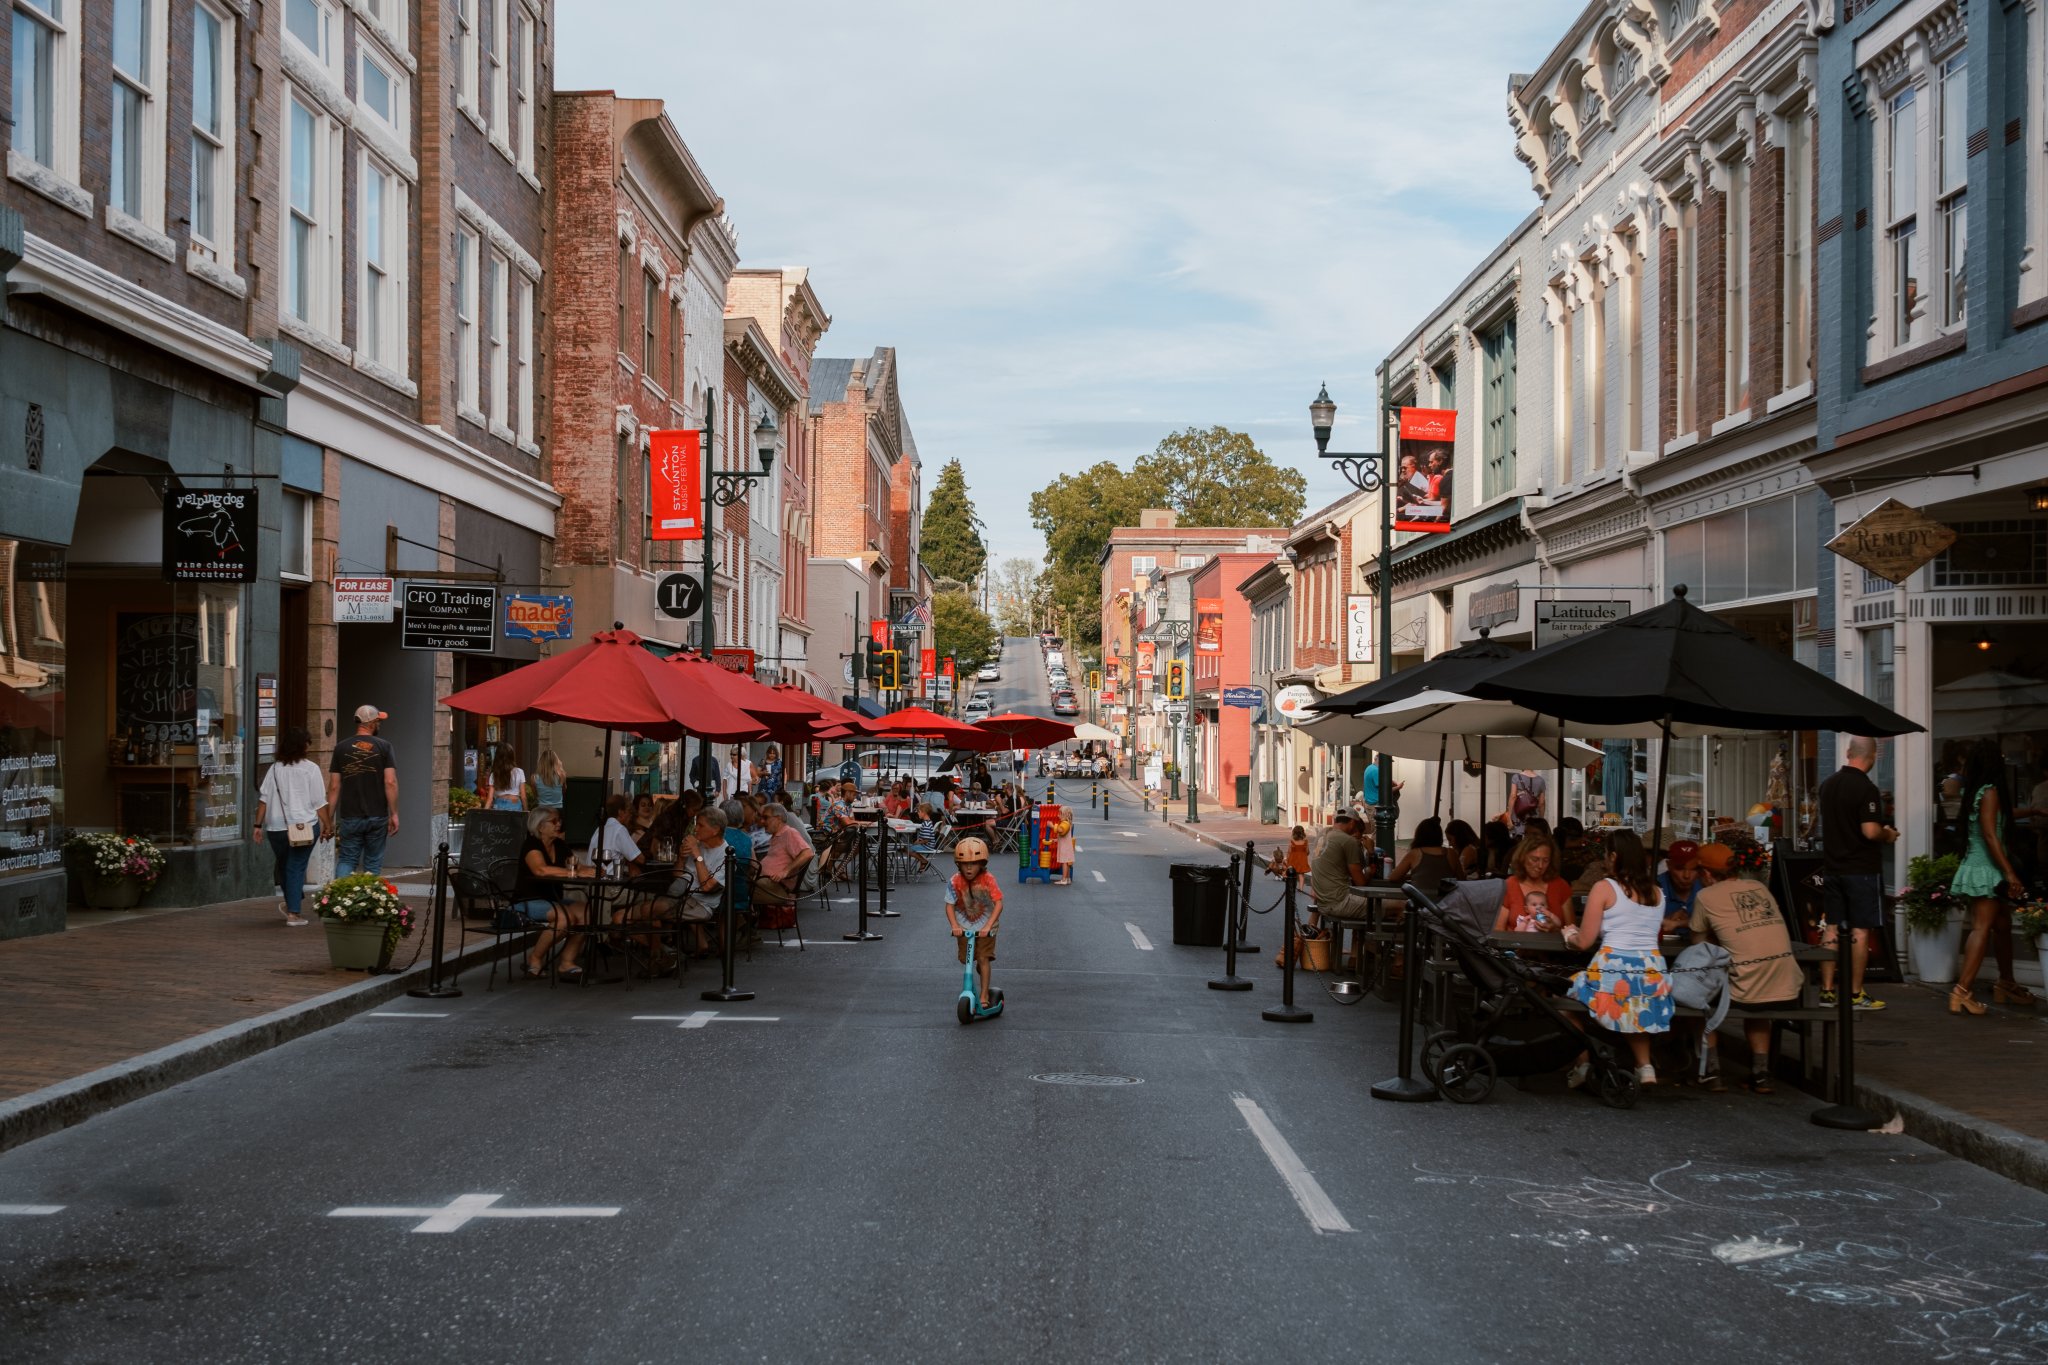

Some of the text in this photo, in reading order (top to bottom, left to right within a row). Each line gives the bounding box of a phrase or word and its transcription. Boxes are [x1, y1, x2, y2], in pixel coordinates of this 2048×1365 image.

[1409, 425, 1447, 433] STAUNTON
[671, 445, 681, 511] STAUNTON
[680, 444, 689, 511] MUSIC FESTIVAL
[176, 492, 245, 509] yelping dog
[1854, 527, 1932, 555] REMEDY
[176, 561, 244, 569] wine cheese
[176, 570, 244, 579] charcuterie
[339, 582, 388, 590] FOR LEASE
[337, 595, 390, 603] OFFICE SPACE
[408, 590, 492, 608] CFO Trading
[666, 583, 695, 609] 17
[429, 605, 469, 614] COMPANY
[1551, 604, 1617, 618] Latitudes
[1551, 622, 1569, 631] fair
[1569, 622, 1594, 631] trade
[427, 637, 469, 648] Dry goods
[141, 645, 196, 667] BEST
[142, 688, 196, 714] SHOP
[144, 724, 196, 742] 2023
[0, 752, 57, 771] artisan cheese
[2, 783, 55, 806] grilled cheese
[5, 802, 51, 821] sandwiches
[480, 821, 512, 834] Please
[10, 832, 36, 850] cheese
[38, 848, 62, 869] plates
